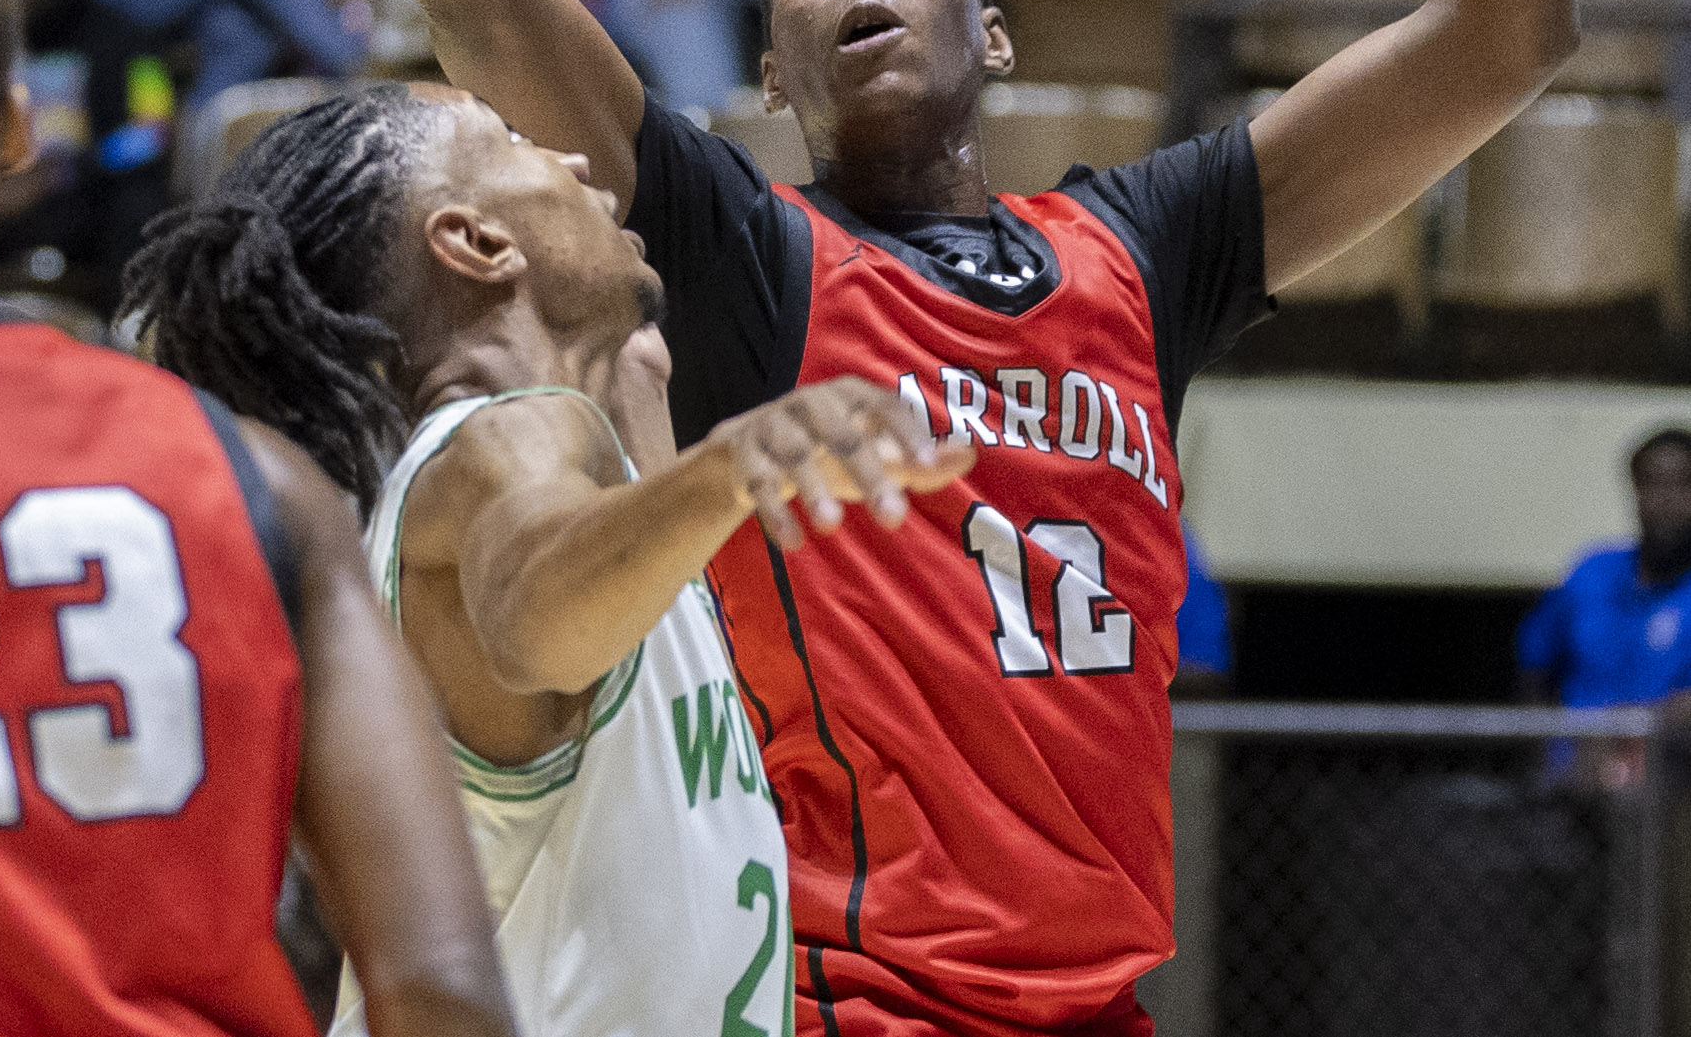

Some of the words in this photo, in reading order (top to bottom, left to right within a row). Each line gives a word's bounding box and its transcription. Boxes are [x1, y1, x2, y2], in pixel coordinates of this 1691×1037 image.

[898, 366, 1170, 510] ARROLL
[961, 501, 1136, 678] 12
[672, 678, 774, 810] WO
